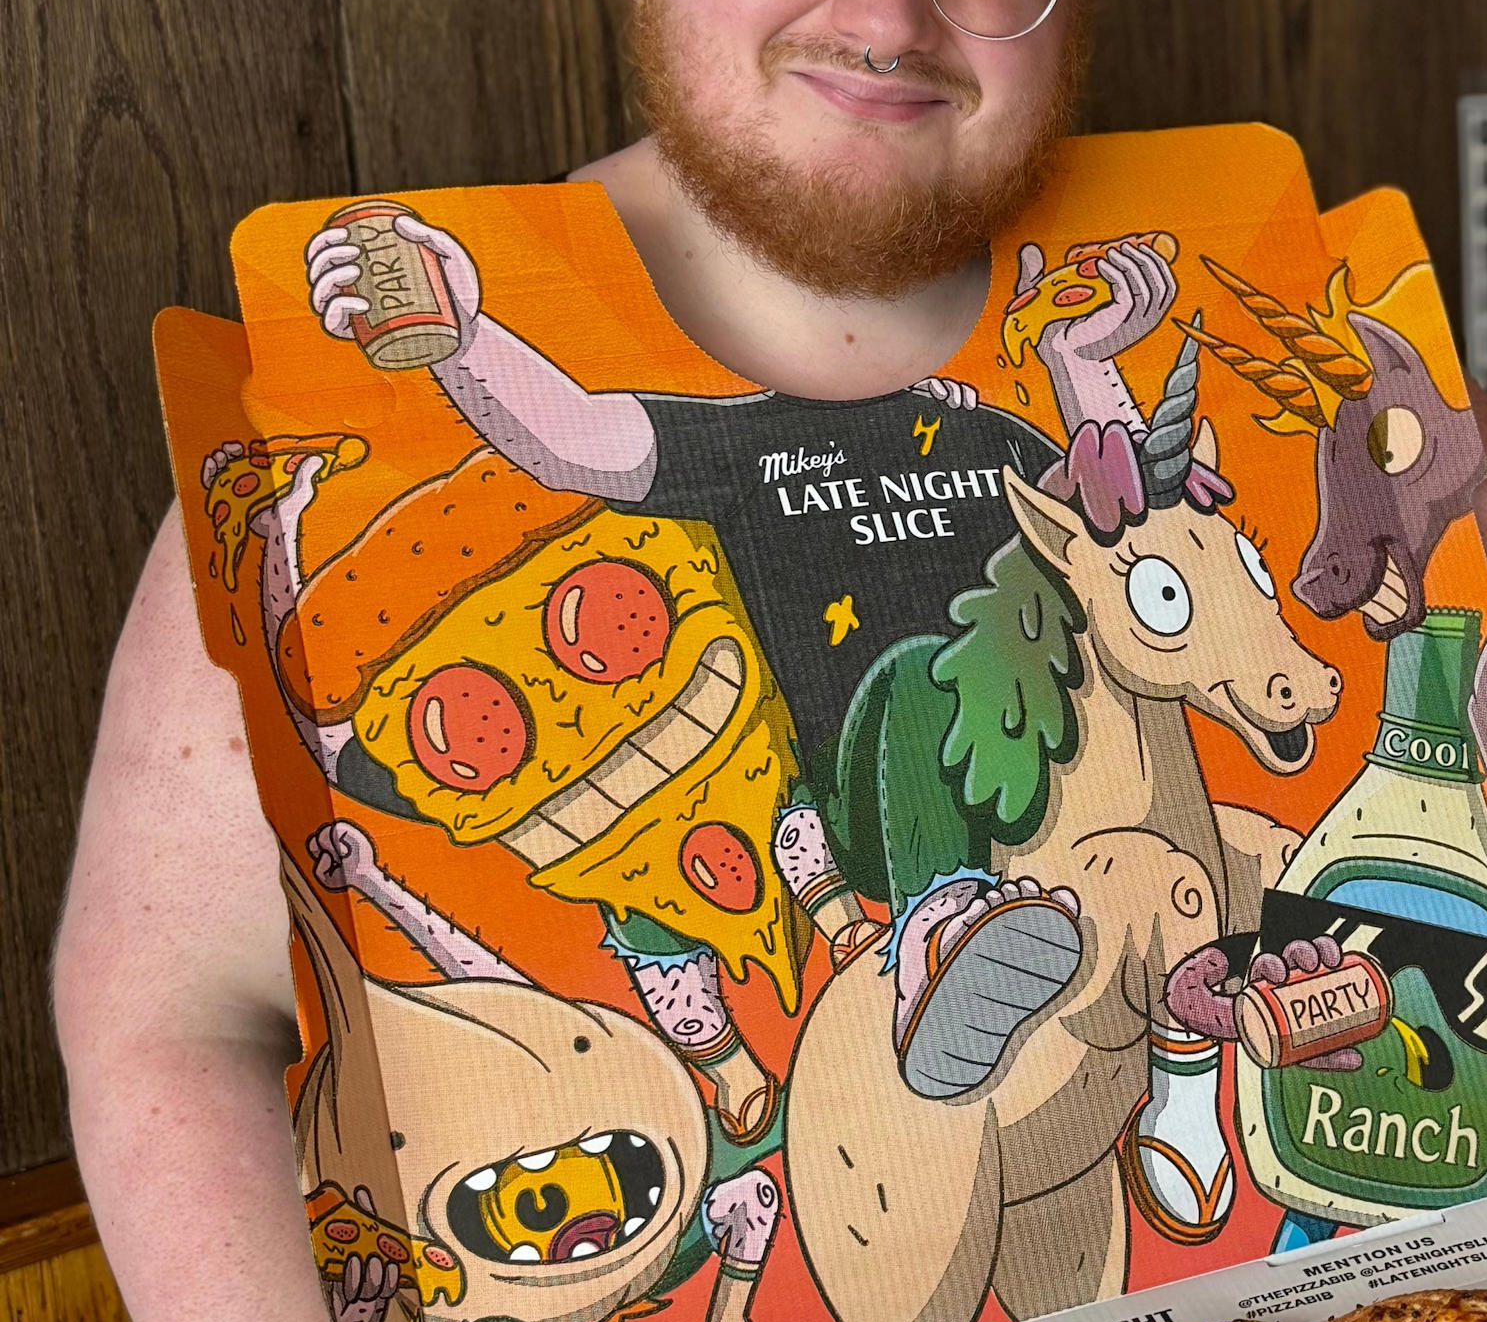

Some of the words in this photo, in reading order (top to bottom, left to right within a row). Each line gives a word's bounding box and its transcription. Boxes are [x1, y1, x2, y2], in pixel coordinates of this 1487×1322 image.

[357, 224, 415, 311] PARTY
[759, 441, 847, 483] Mikey's
[777, 479, 869, 516] LATE
[880, 468, 1000, 506] NIGHT
[850, 508, 955, 546] SLICE
[1290, 978, 1370, 1030] PARTY
[1301, 1083, 1479, 1168] Ranch
[1302, 1244, 1403, 1279] MENTION
[1406, 1236, 1436, 1251] US
[1238, 1272, 1356, 1308] @THEPIZZABIB
[1246, 1291, 1334, 1319] #PIZZABIB
